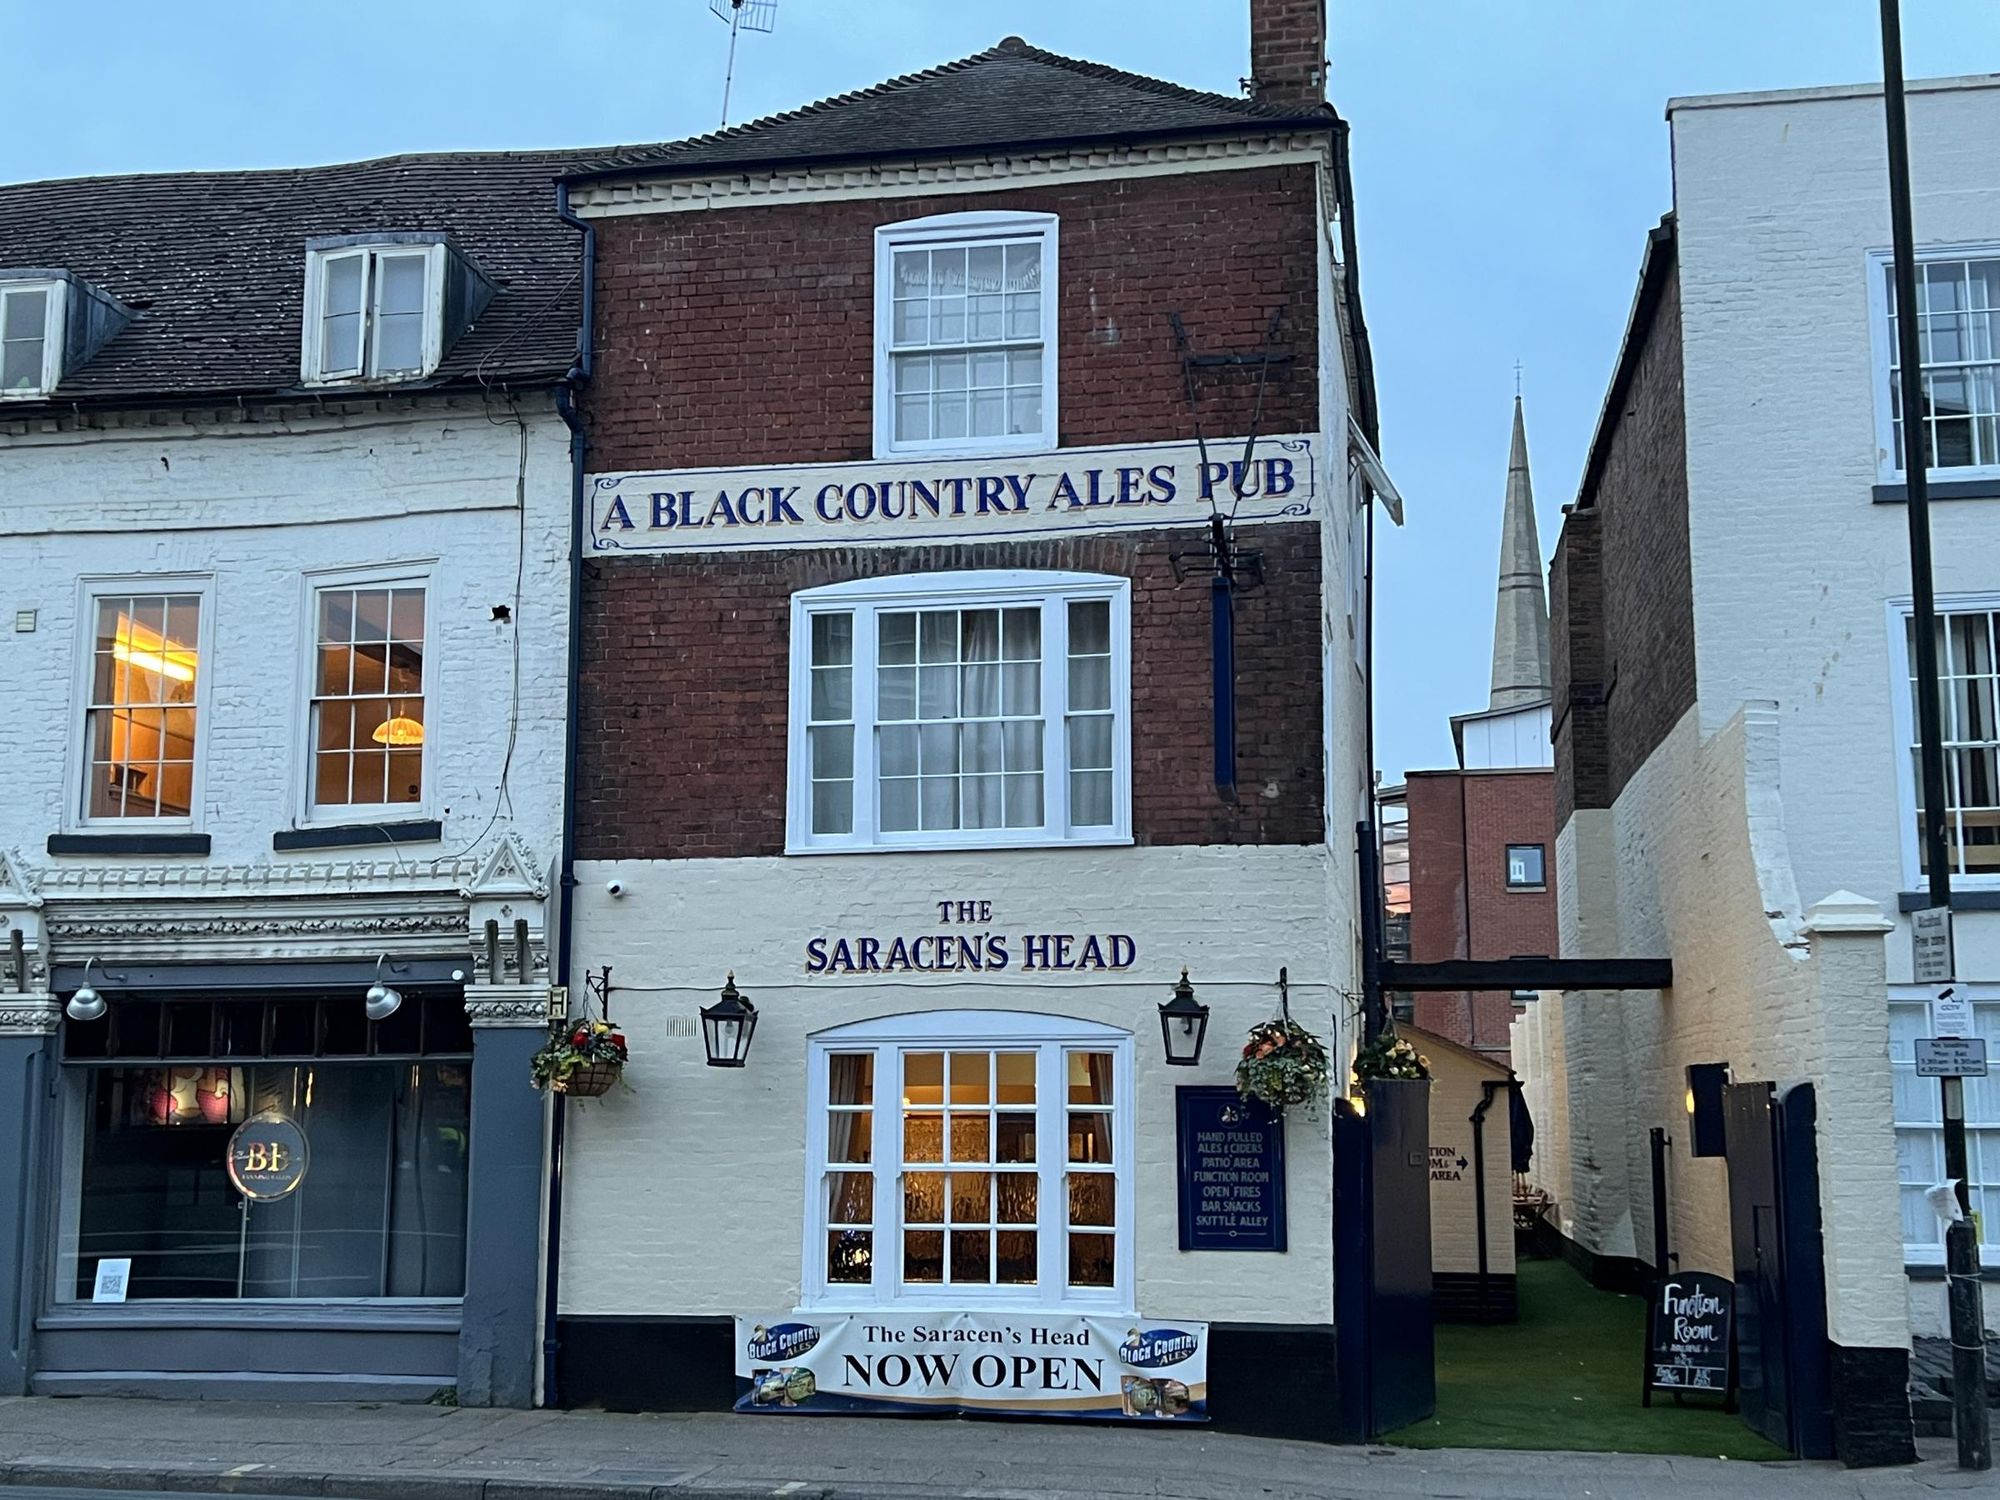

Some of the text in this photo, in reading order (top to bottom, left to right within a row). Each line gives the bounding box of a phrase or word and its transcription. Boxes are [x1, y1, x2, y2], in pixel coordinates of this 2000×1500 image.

[600, 457, 1297, 532] A BLACK COUNTRY ALES PUB
[937, 900, 993, 924] THE
[805, 931, 1137, 974] SARACEN'S HEAD
[1197, 1132, 1263, 1143] HAND PULLED
[1198, 1143, 1223, 1153] ALES
[1230, 1143, 1263, 1154] CIDERS
[1202, 1157, 1260, 1168] PATIO AREA
[1193, 1171, 1269, 1182] FUNCTION ROOM
[1430, 1170, 1461, 1181] AREA
[1202, 1186, 1261, 1197] OPEN FIRES
[1201, 1201, 1261, 1212] BAR SNACKS
[1196, 1215, 1269, 1226] SKITTLE ALLEY
[1664, 1283, 1725, 1319] Function
[1674, 1316, 1719, 1343] Room
[863, 1325, 1091, 1346] The Saracen's Head
[842, 1353, 1105, 1392] NOW OPEN
